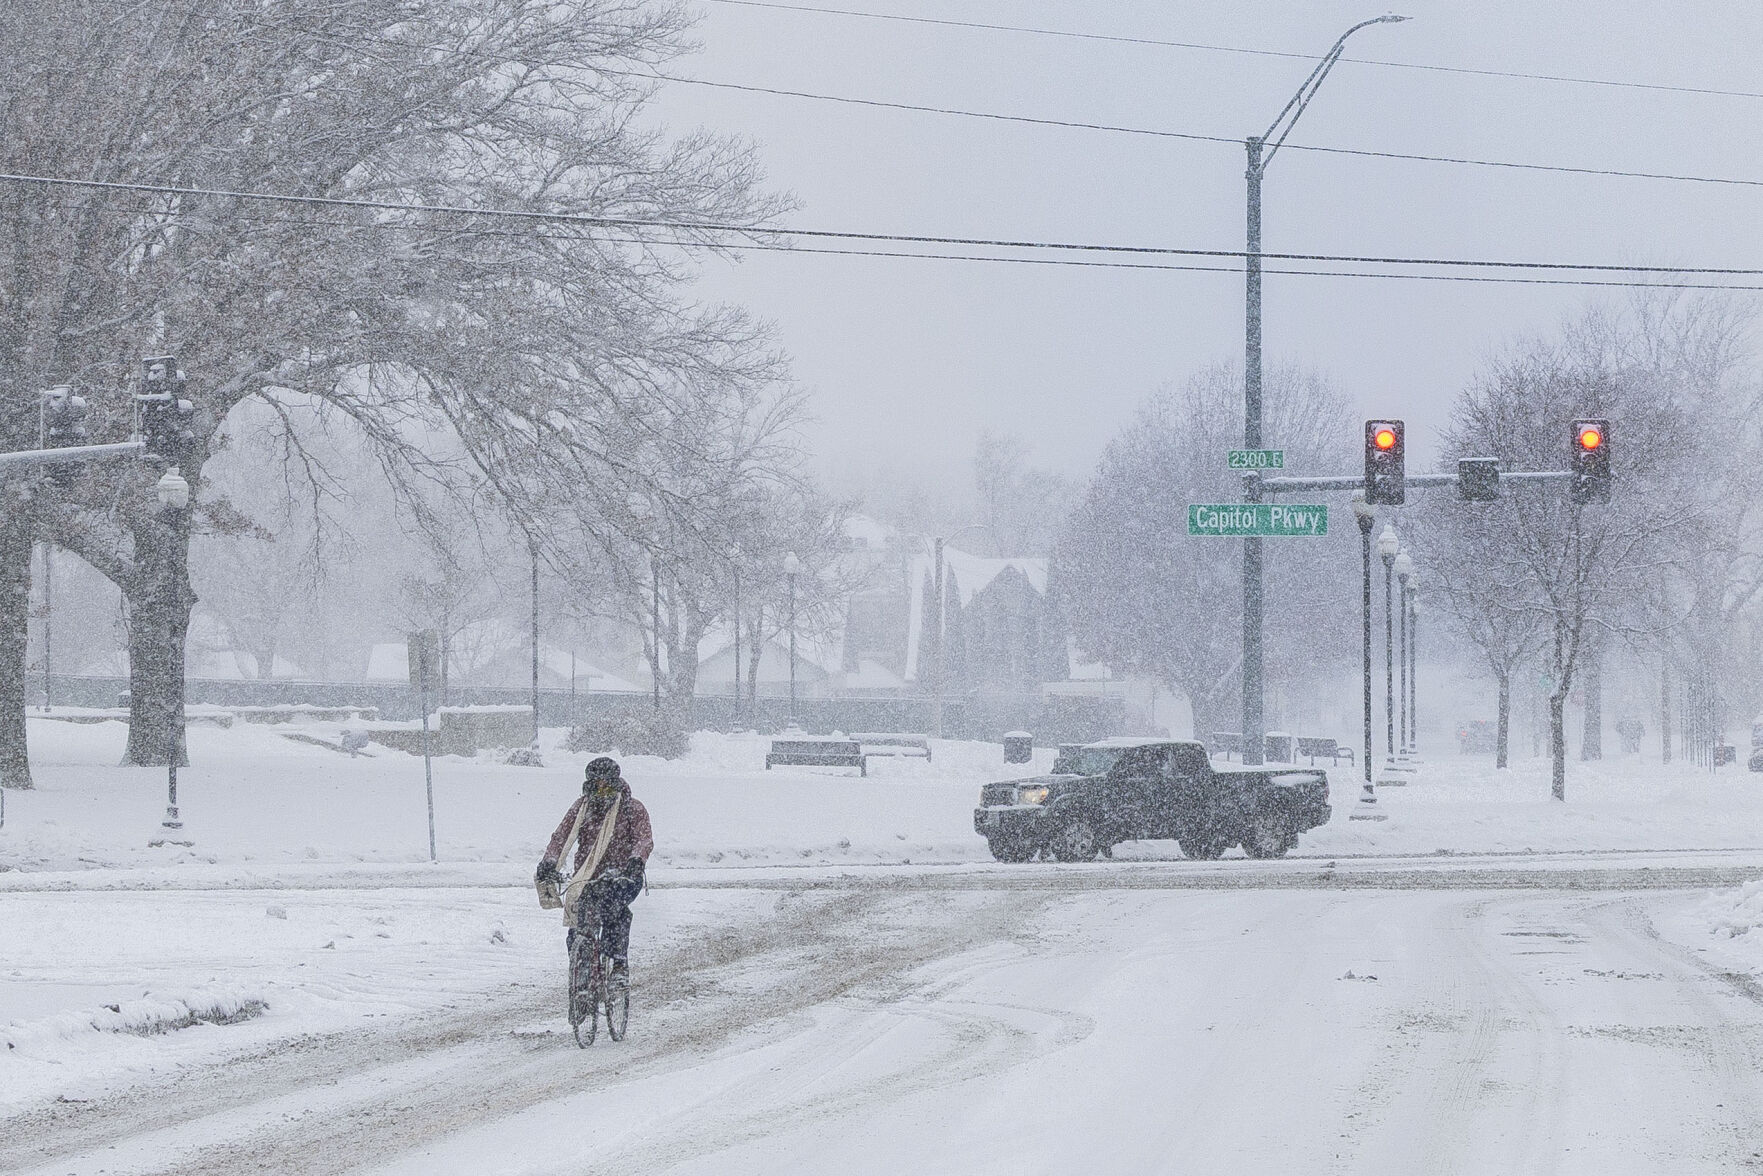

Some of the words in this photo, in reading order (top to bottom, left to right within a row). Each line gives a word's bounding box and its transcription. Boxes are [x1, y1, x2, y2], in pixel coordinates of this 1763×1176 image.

[1231, 452, 1267, 467] 2300
[1273, 452, 1281, 467] E
[1196, 507, 1257, 532] Capitol
[1271, 507, 1320, 533] Pkwy
